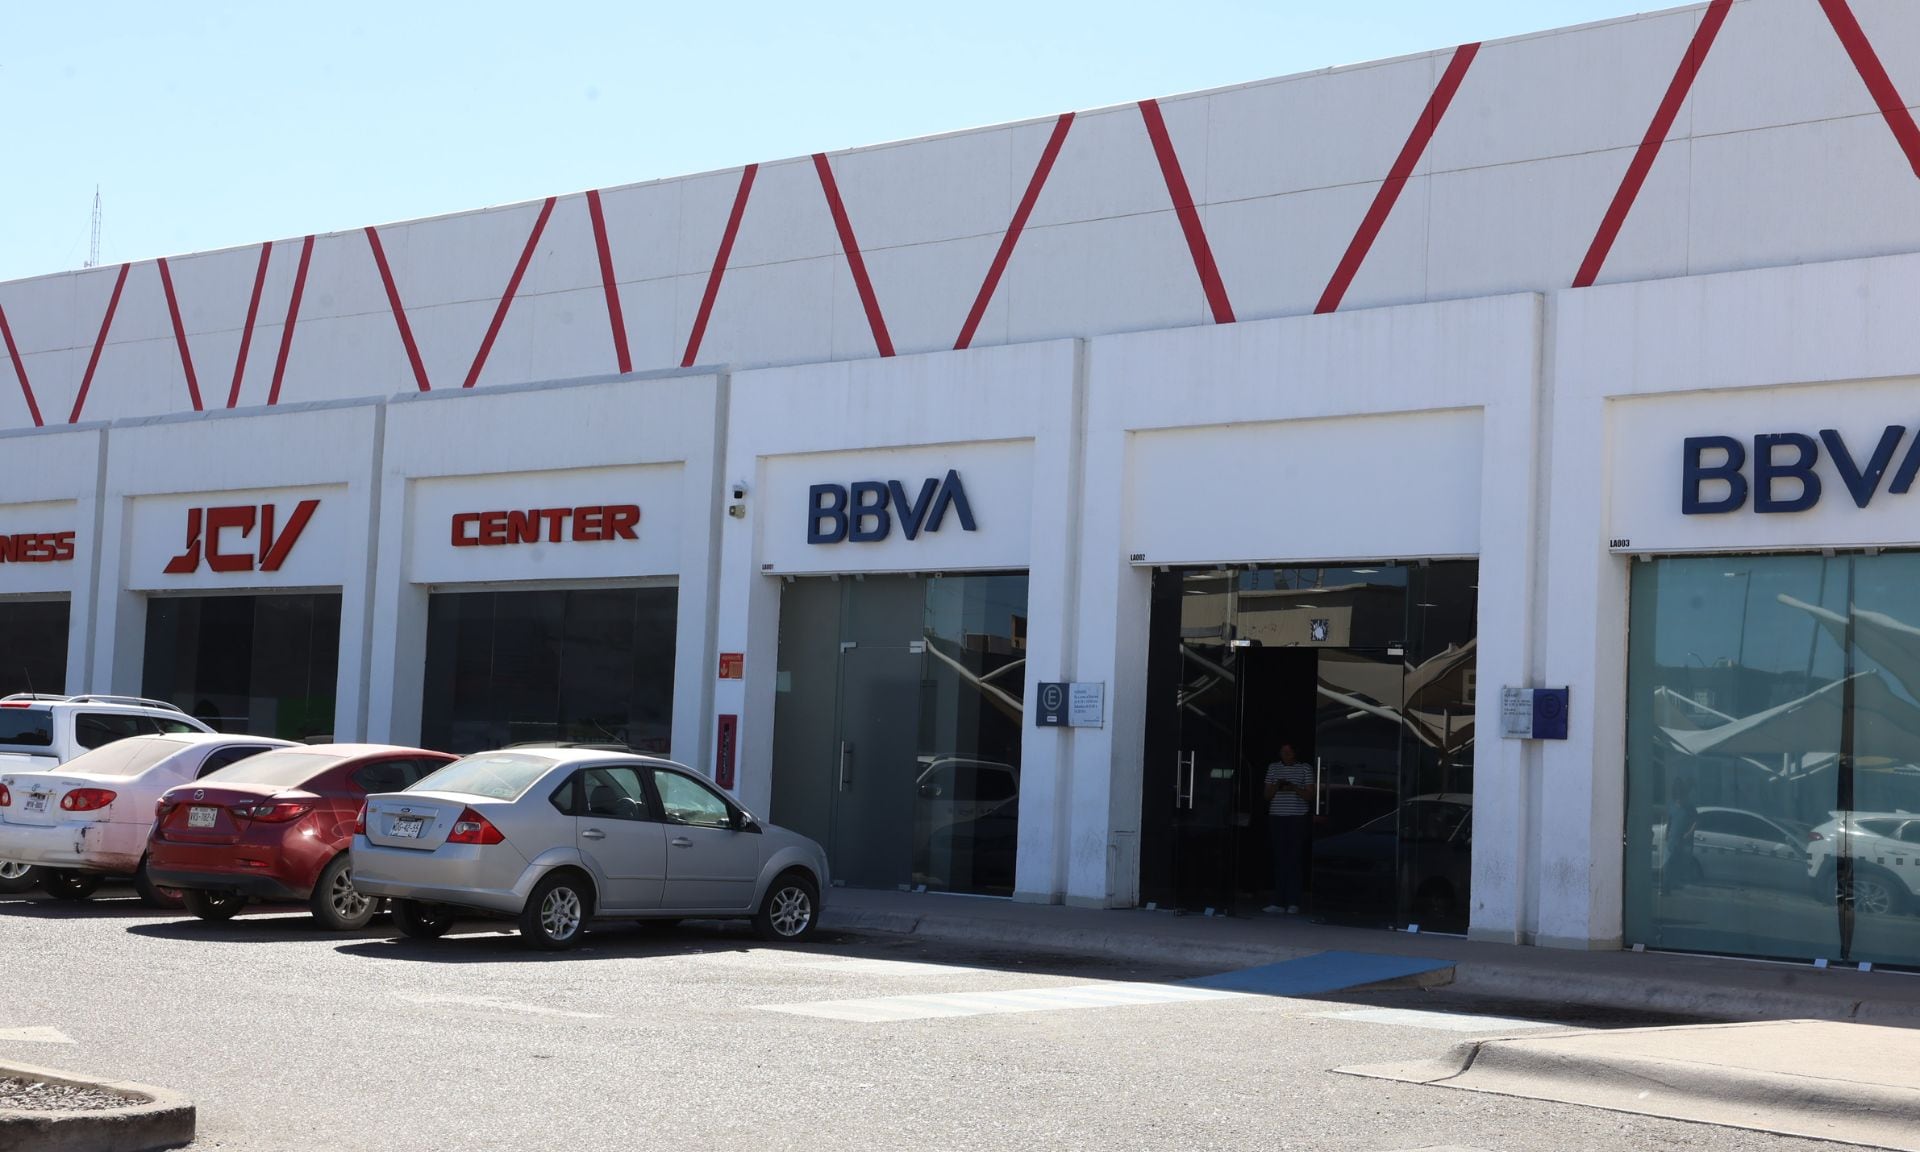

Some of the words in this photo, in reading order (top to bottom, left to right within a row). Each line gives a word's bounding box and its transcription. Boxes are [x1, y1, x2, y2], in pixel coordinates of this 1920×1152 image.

[163, 500, 321, 573] JCV
[451, 505, 640, 546] CENTER
[807, 469, 977, 544] BBVA
